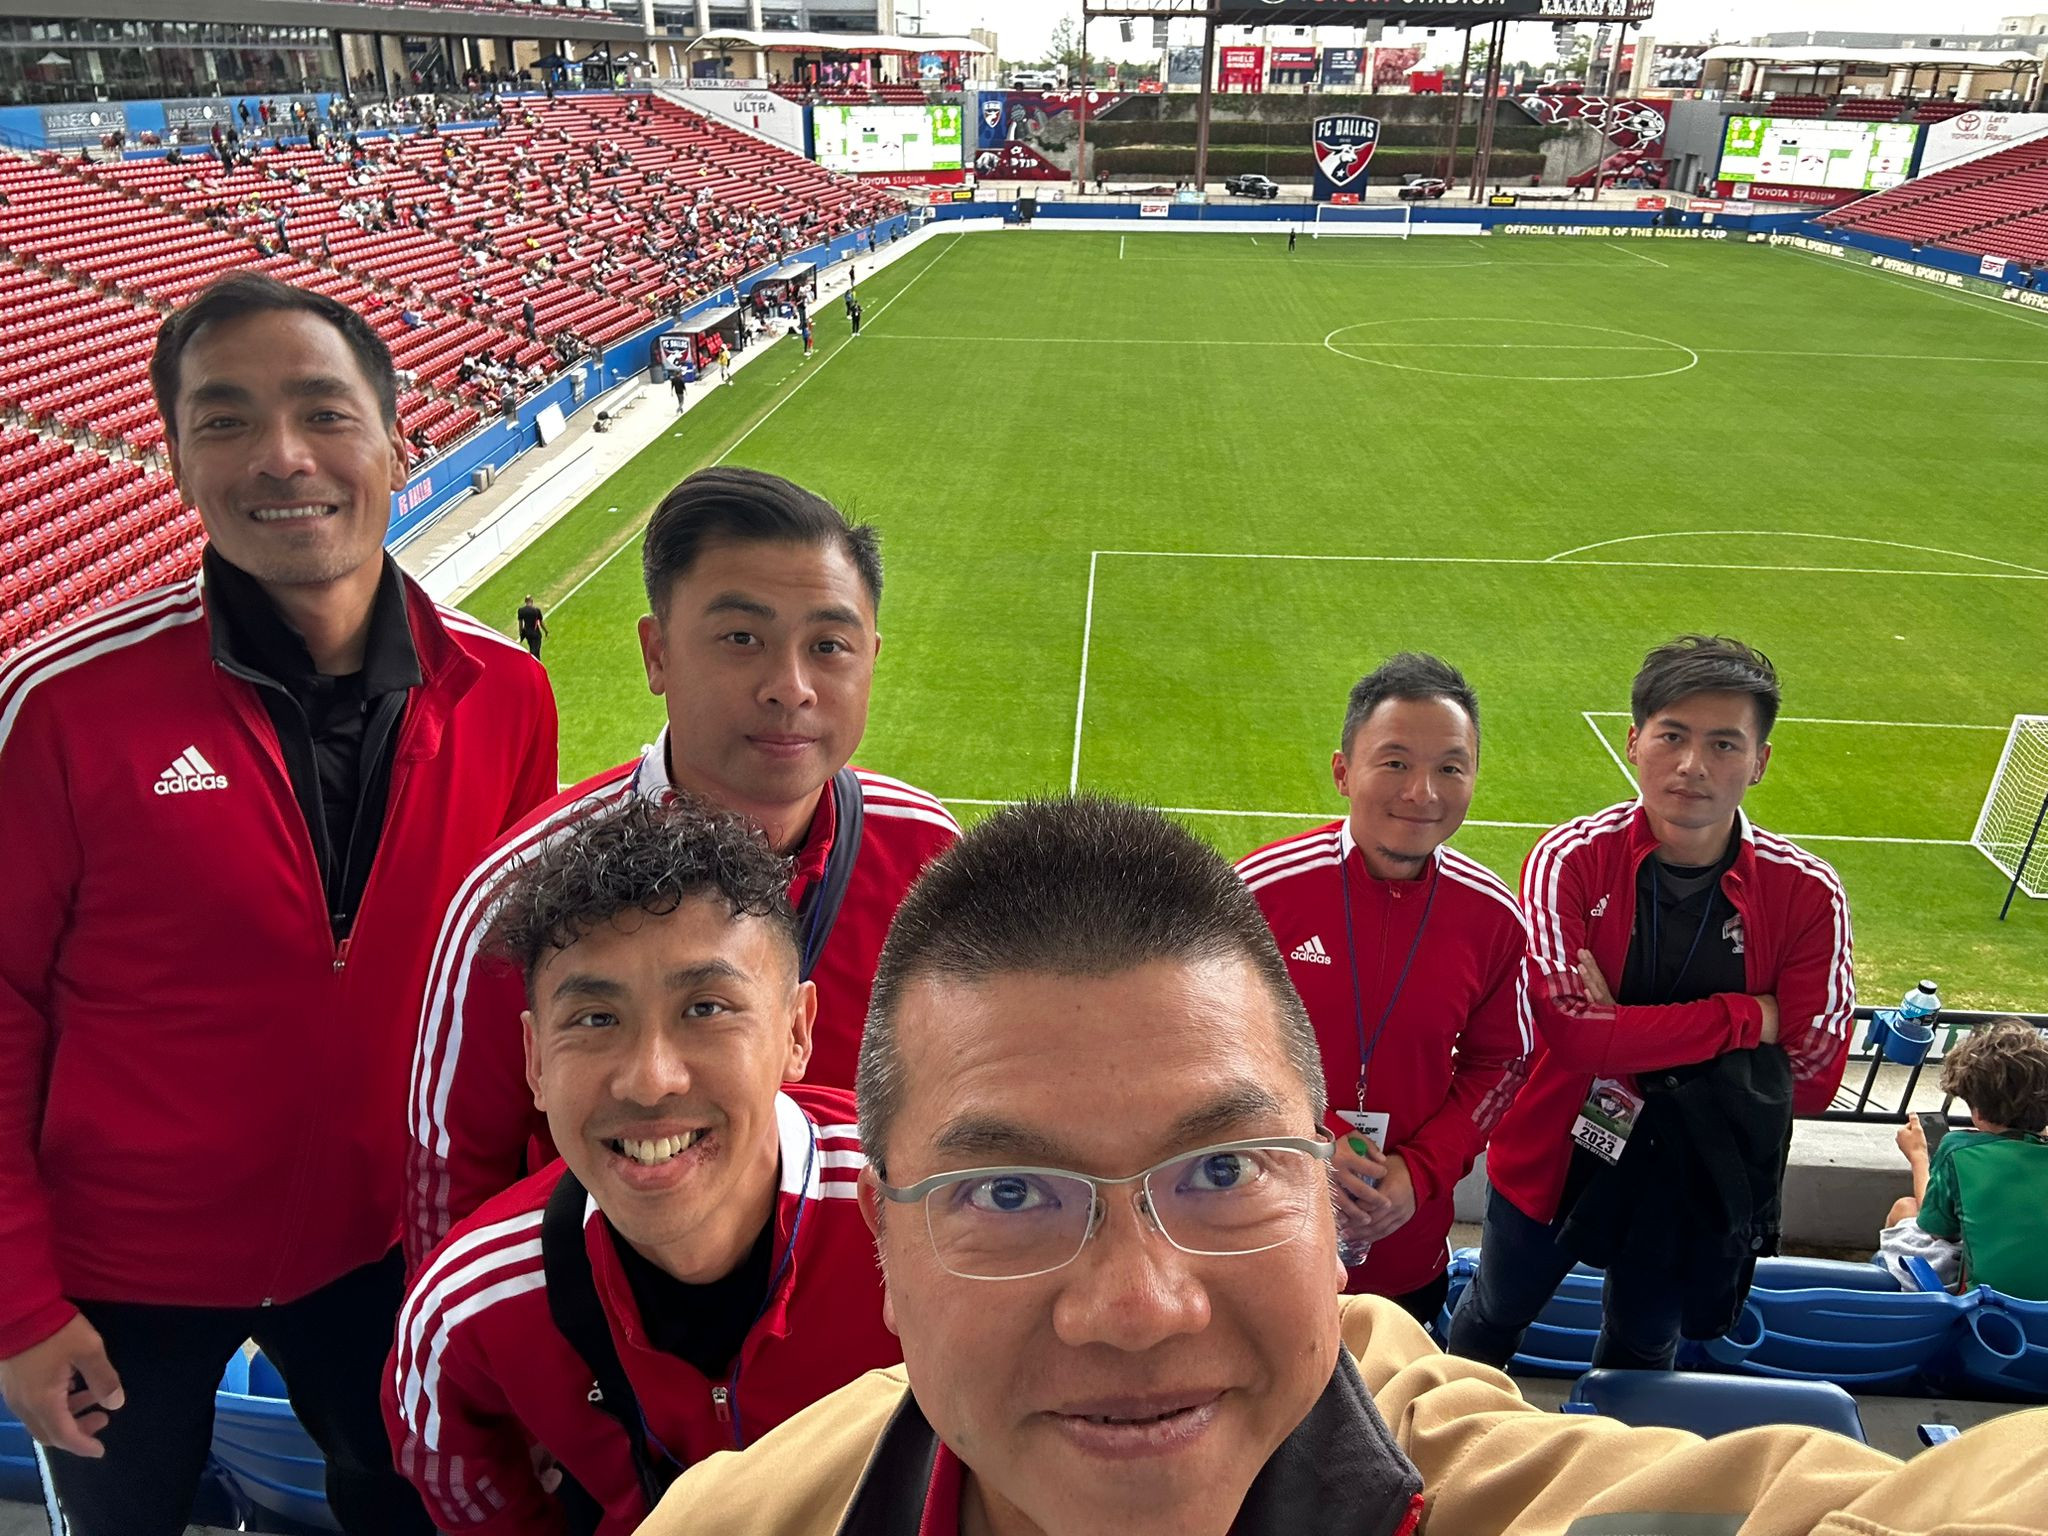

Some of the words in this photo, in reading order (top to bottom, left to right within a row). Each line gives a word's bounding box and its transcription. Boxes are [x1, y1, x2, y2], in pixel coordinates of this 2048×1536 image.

[733, 102, 776, 113] ULTRA
[1989, 115, 2008, 124] Let's
[1318, 121, 1332, 138] FC
[1336, 120, 1374, 138] DALLAS
[1987, 123, 1999, 132] Go
[893, 175, 926, 185] STADIUM
[1752, 187, 1790, 198] TOYOTA
[1792, 190, 1836, 201] STADIUM
[1504, 224, 1555, 236] OFFICIAL
[1557, 225, 1611, 236] PARTNER
[1612, 226, 1629, 237] OF
[1630, 227, 1654, 237] THE
[1655, 228, 1699, 238] DALLAS
[1701, 229, 1728, 240] CUP
[1883, 258, 1915, 276] OFFICIAL
[1915, 265, 1947, 283] SPORTS
[153, 773, 229, 796] adidas
[1290, 950, 1332, 965] adidas
[1579, 1126, 1615, 1155] 2023
